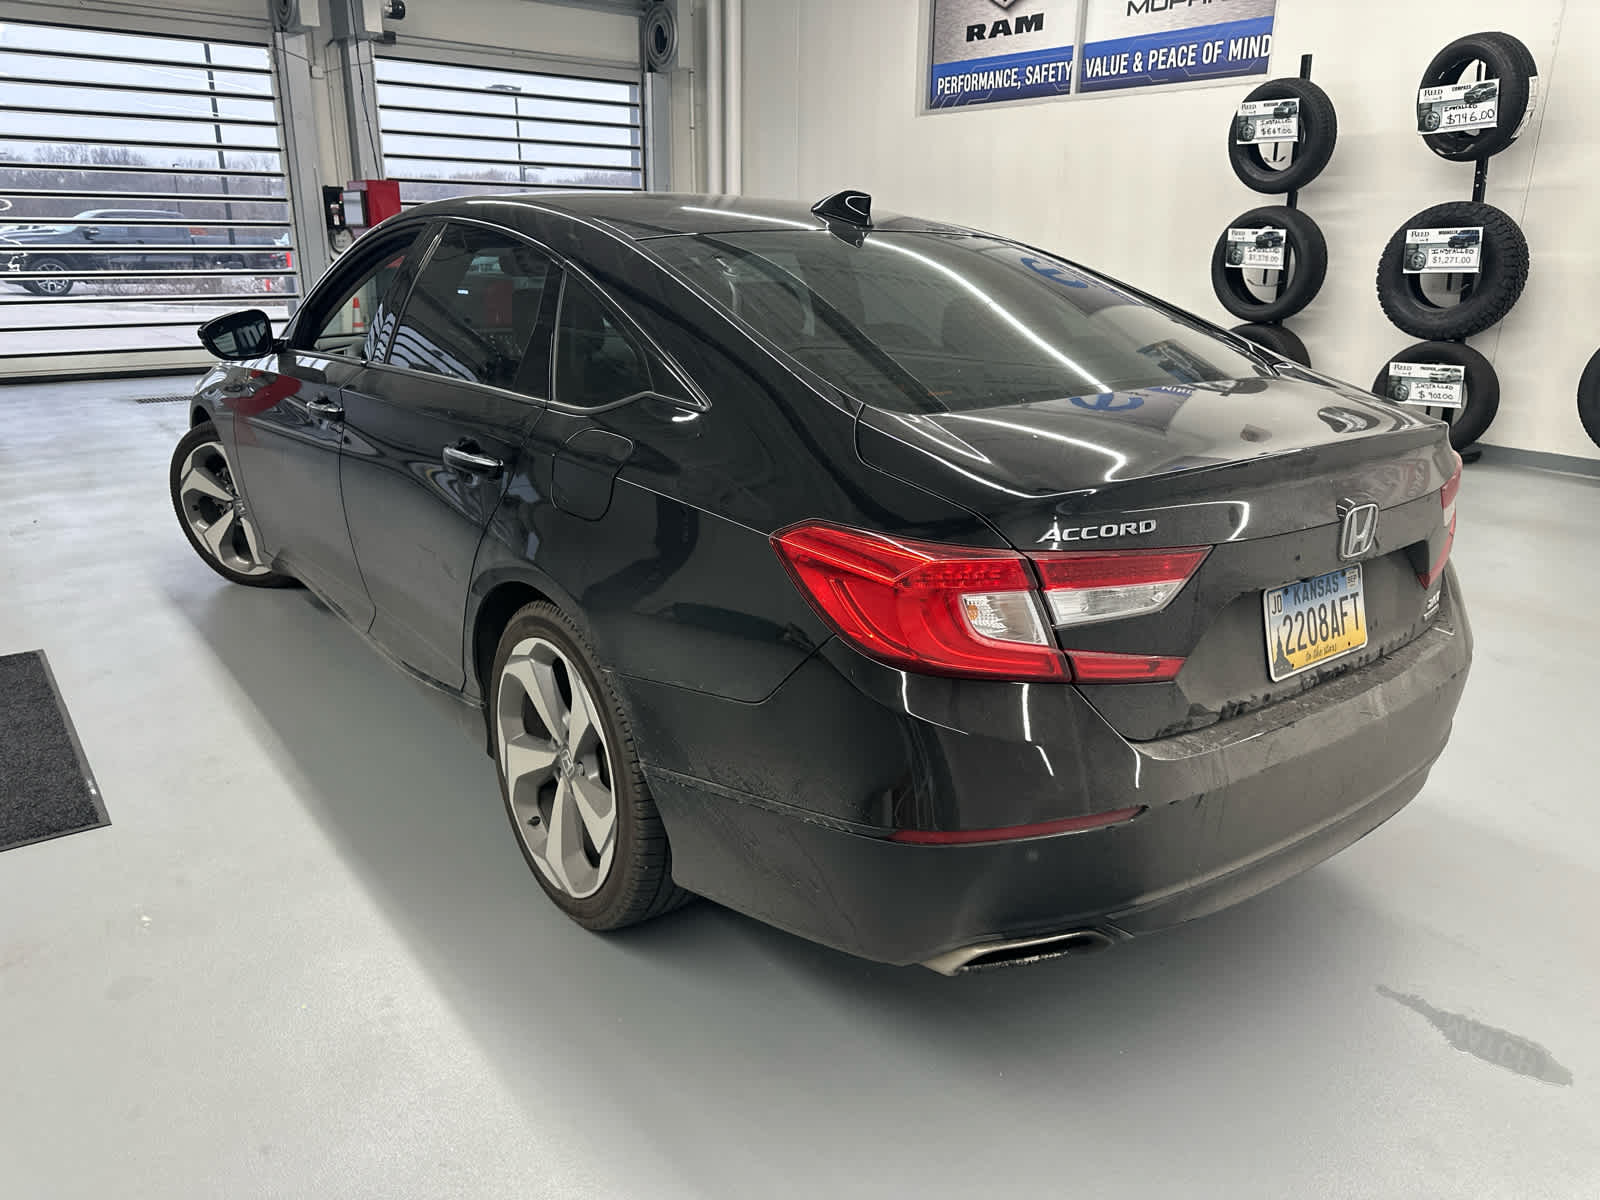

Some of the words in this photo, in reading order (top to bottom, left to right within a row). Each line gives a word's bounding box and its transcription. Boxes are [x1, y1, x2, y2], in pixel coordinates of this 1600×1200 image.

[1127, 0, 1225, 16] MOP
[966, 13, 1044, 42] RAM
[1086, 53, 1129, 78] VALUE
[1133, 51, 1143, 73] &
[1148, 44, 1198, 71] PEACE
[1202, 40, 1224, 65] OF
[1229, 34, 1272, 61] MIND
[937, 67, 1021, 95] PERFORMANCE,
[1025, 60, 1072, 84] SAFETY
[1446, 109, 1495, 125] $746.00
[1432, 256, 1471, 265] $1,271.00
[1036, 519, 1157, 543] ACCORD
[1294, 574, 1339, 606] KANSAS
[1272, 594, 1283, 615] JO
[1283, 592, 1359, 656] 2208AFT
